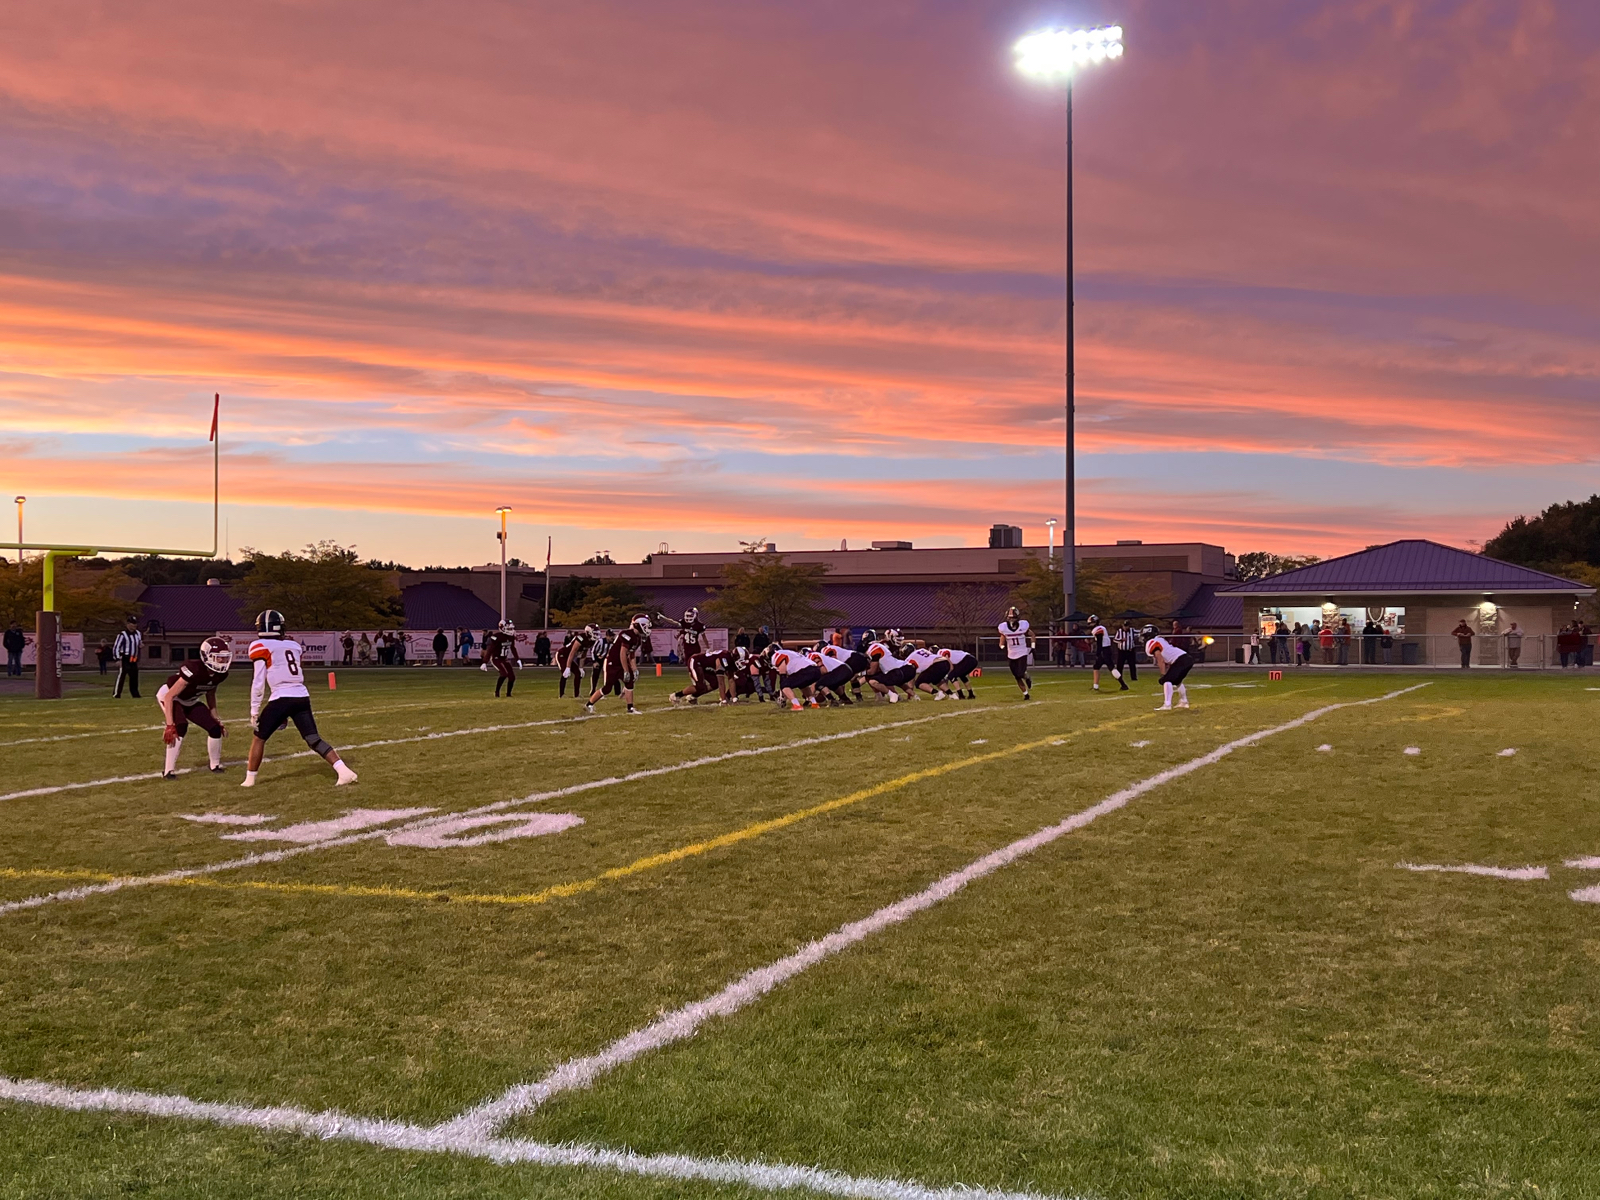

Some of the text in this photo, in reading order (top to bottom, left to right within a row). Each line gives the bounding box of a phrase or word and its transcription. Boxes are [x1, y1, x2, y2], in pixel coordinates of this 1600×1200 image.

[684, 632, 697, 644] 45
[1011, 637, 1020, 646] 11
[54, 615, 62, 678] VIKINGS
[284, 649, 299, 676] 8
[972, 669, 979, 678] G
[1270, 671, 1281, 681] 10
